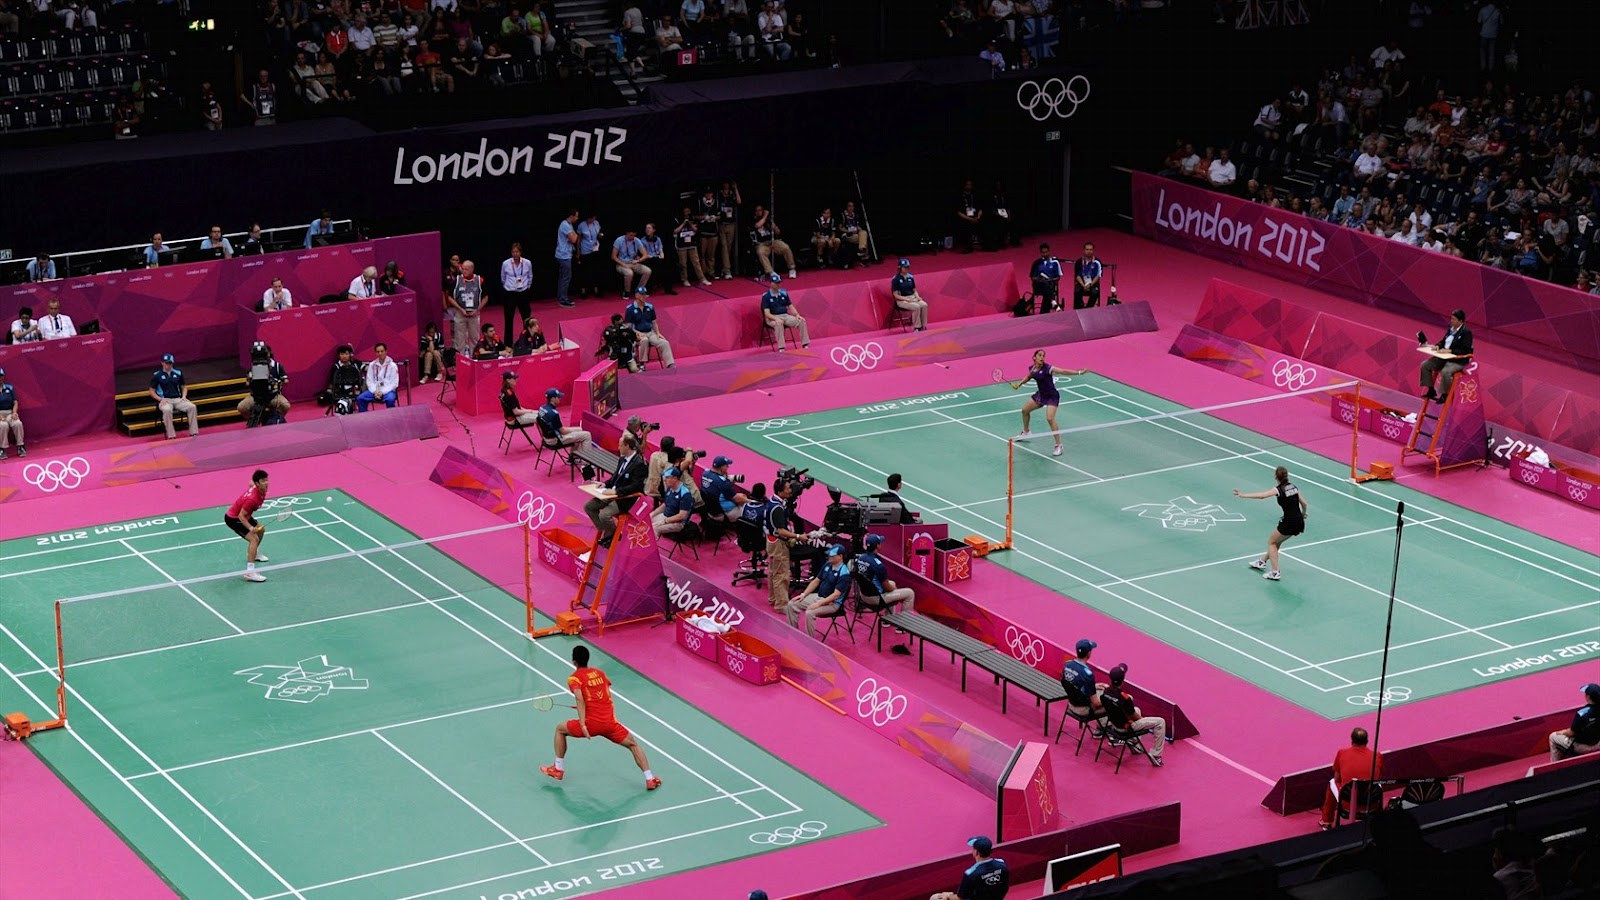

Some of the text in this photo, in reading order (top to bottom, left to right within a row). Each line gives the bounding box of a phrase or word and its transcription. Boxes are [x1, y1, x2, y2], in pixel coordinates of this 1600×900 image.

[394, 126, 627, 184] London 2012
[1156, 188, 1326, 272] London 2012
[1466, 362, 1478, 375] 2
[856, 392, 970, 414] London 2012
[636, 501, 648, 516] 1
[37, 516, 179, 546] London 2012
[1472, 641, 1600, 677] London 2012
[596, 857, 664, 881] 2012
